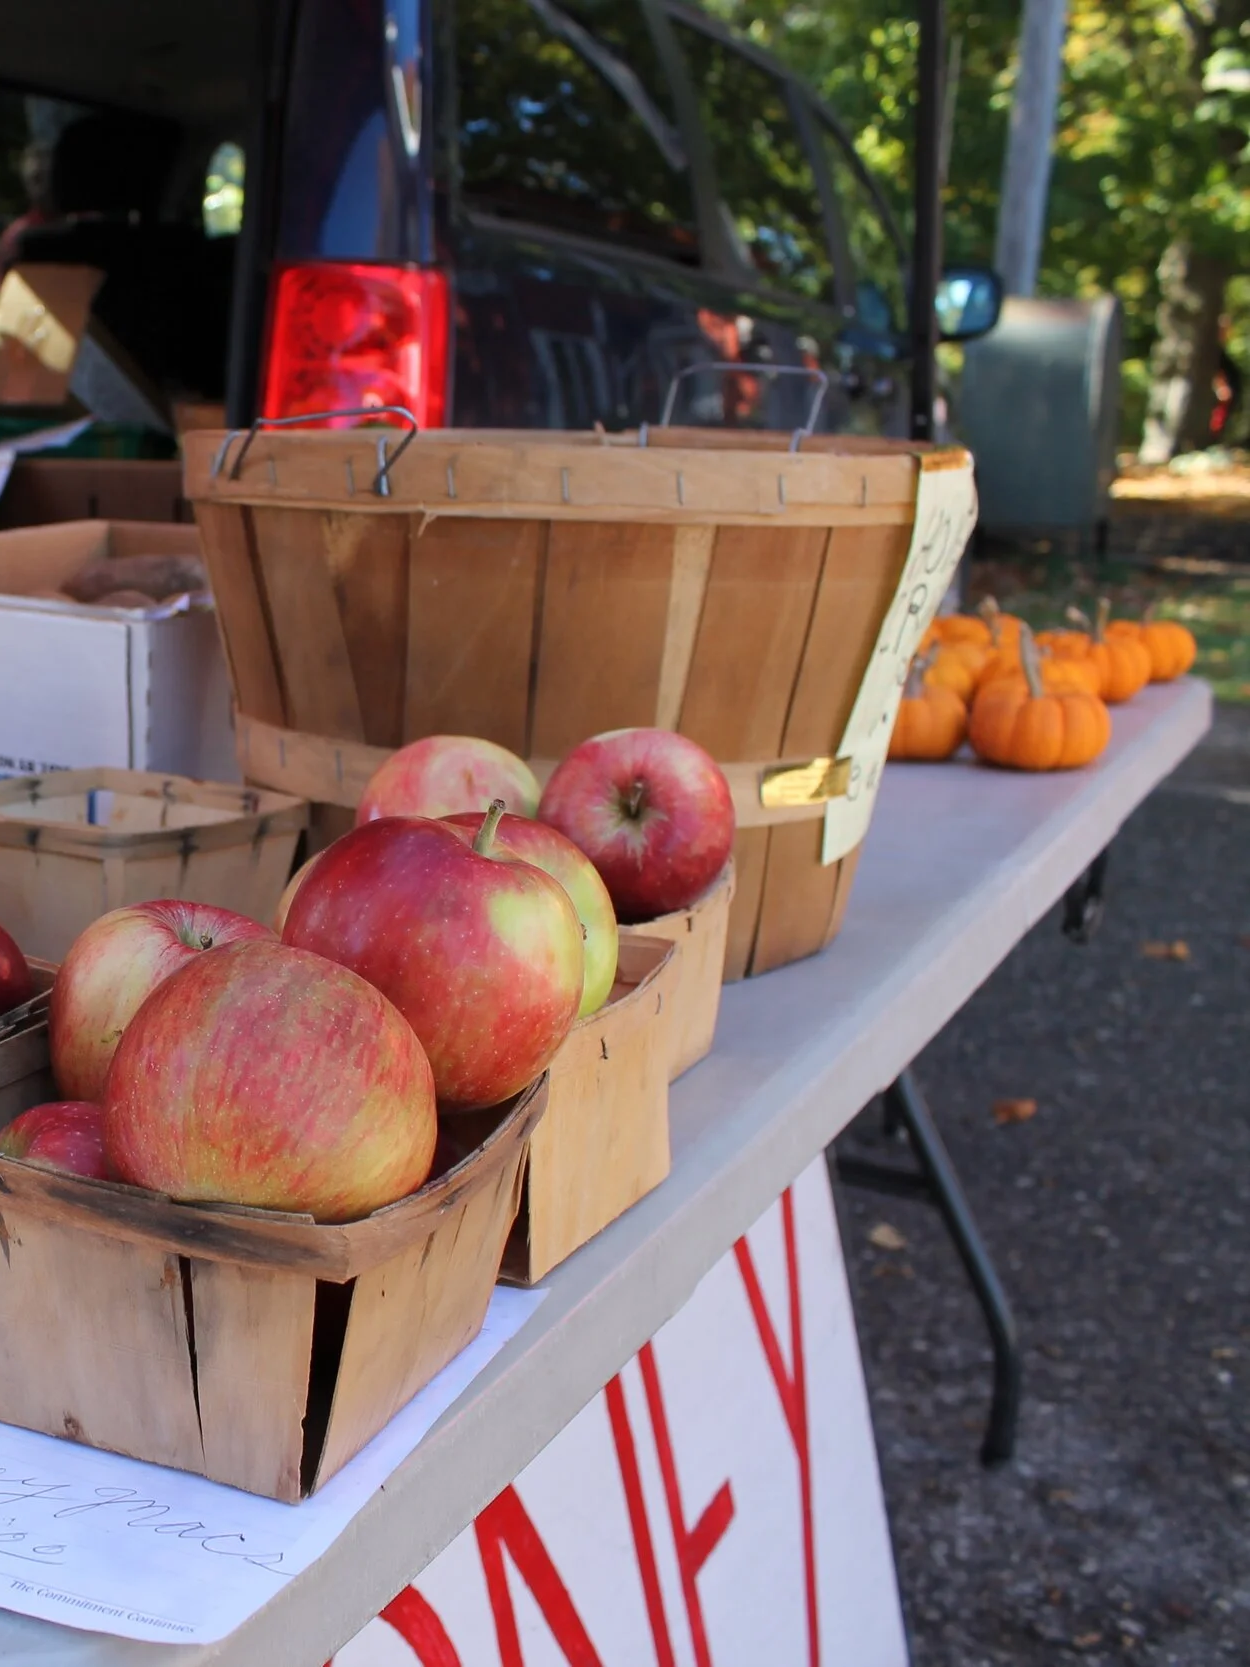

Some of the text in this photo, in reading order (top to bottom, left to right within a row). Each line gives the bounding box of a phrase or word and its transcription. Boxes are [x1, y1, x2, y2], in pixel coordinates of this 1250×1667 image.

[9, 1578, 196, 1635] The Commitment Continues
